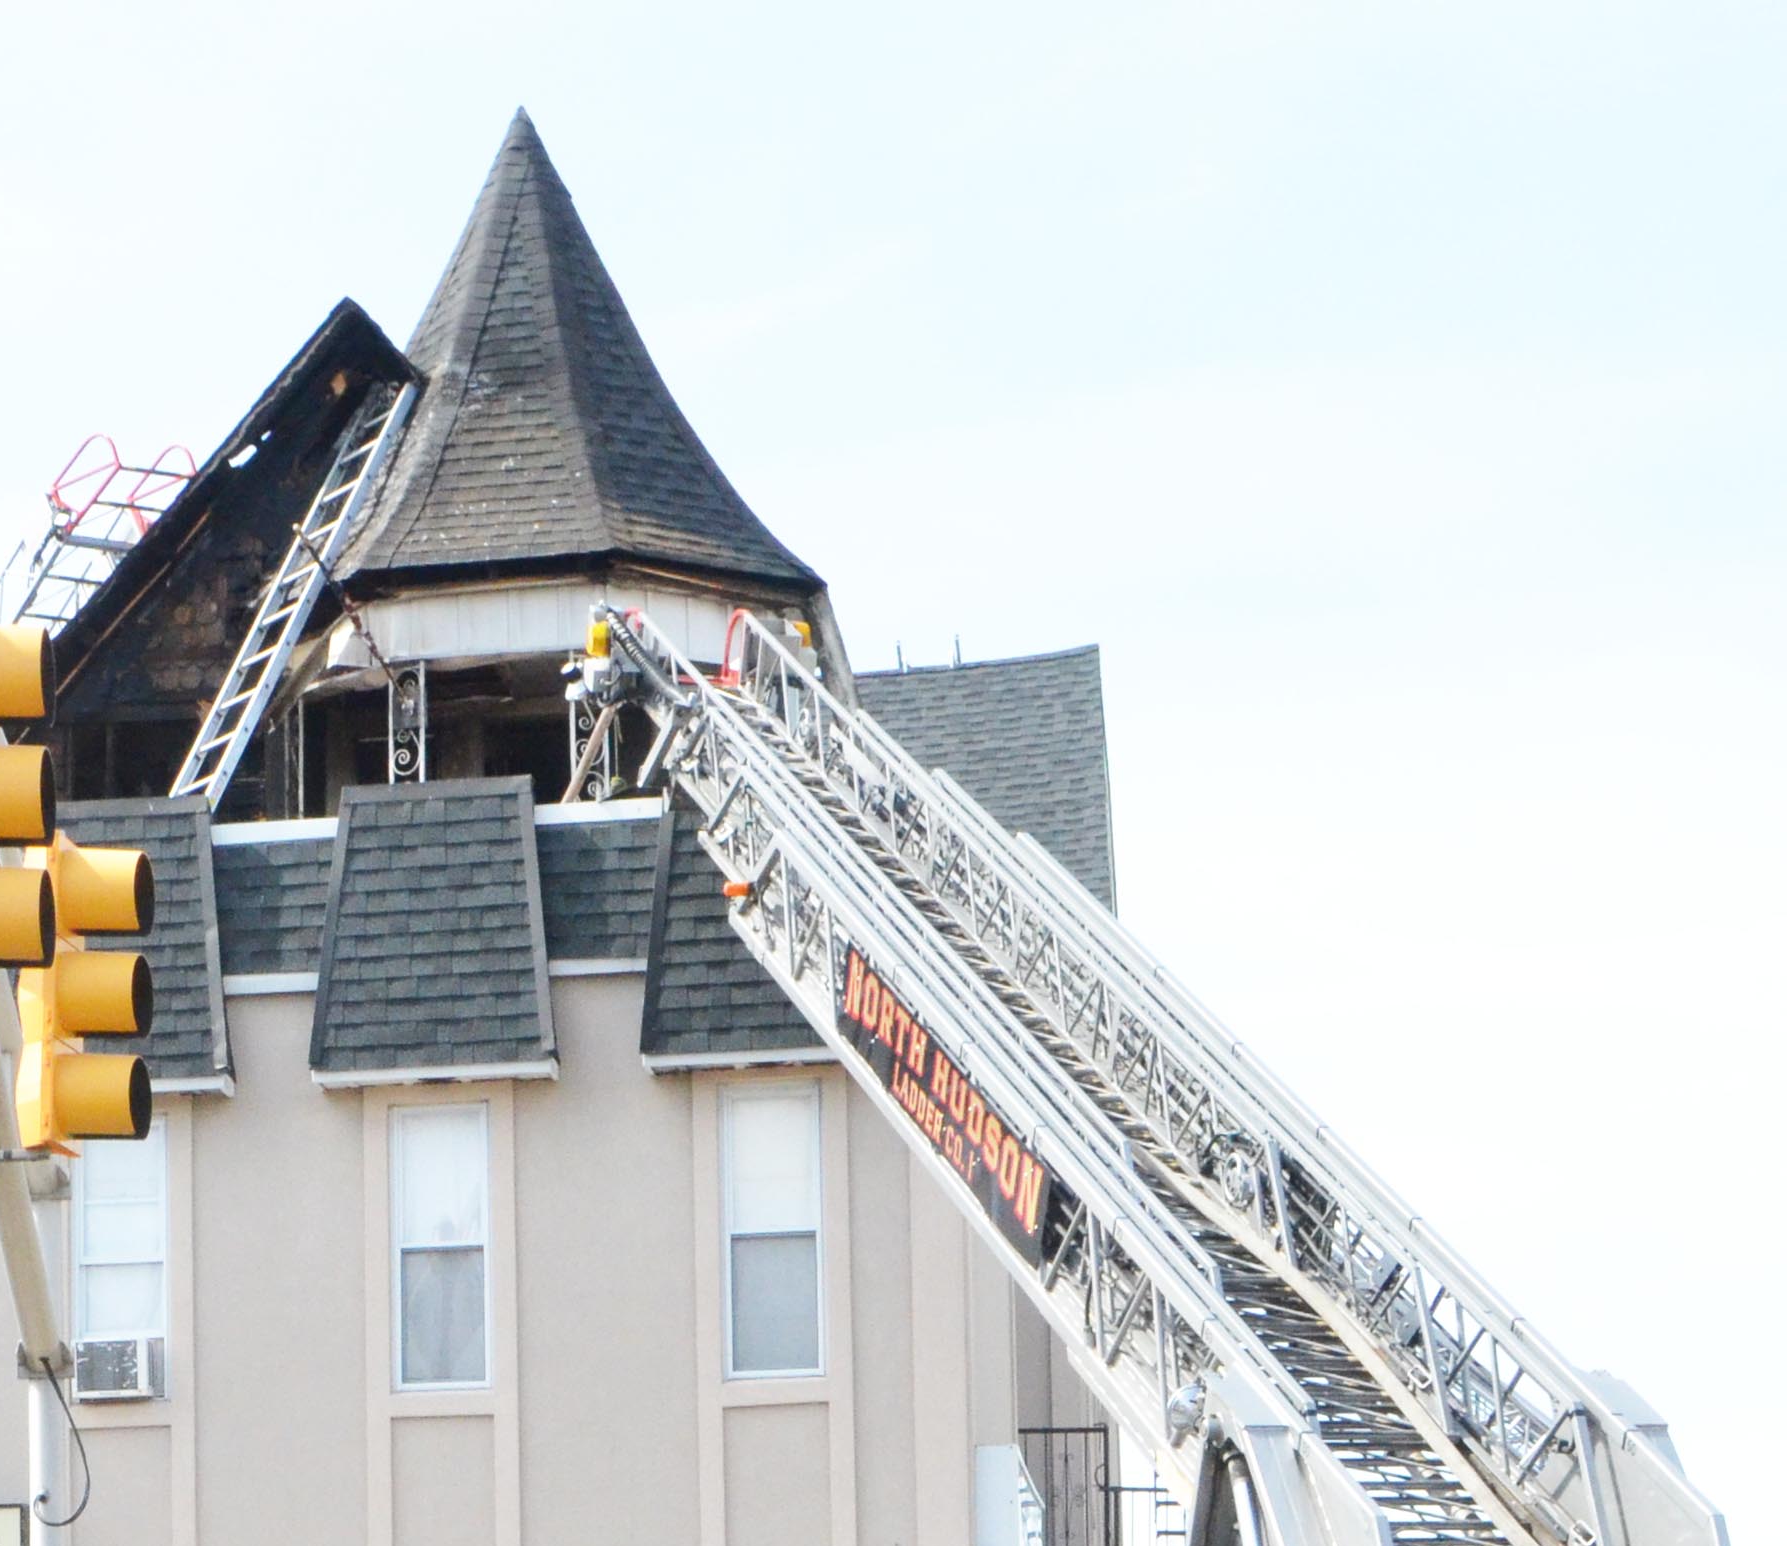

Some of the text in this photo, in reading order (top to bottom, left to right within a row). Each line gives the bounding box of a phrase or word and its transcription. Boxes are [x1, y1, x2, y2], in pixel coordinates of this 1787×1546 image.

[845, 950, 1044, 1236] NORTH HUDSON
[891, 1061, 944, 1146] LADDER
